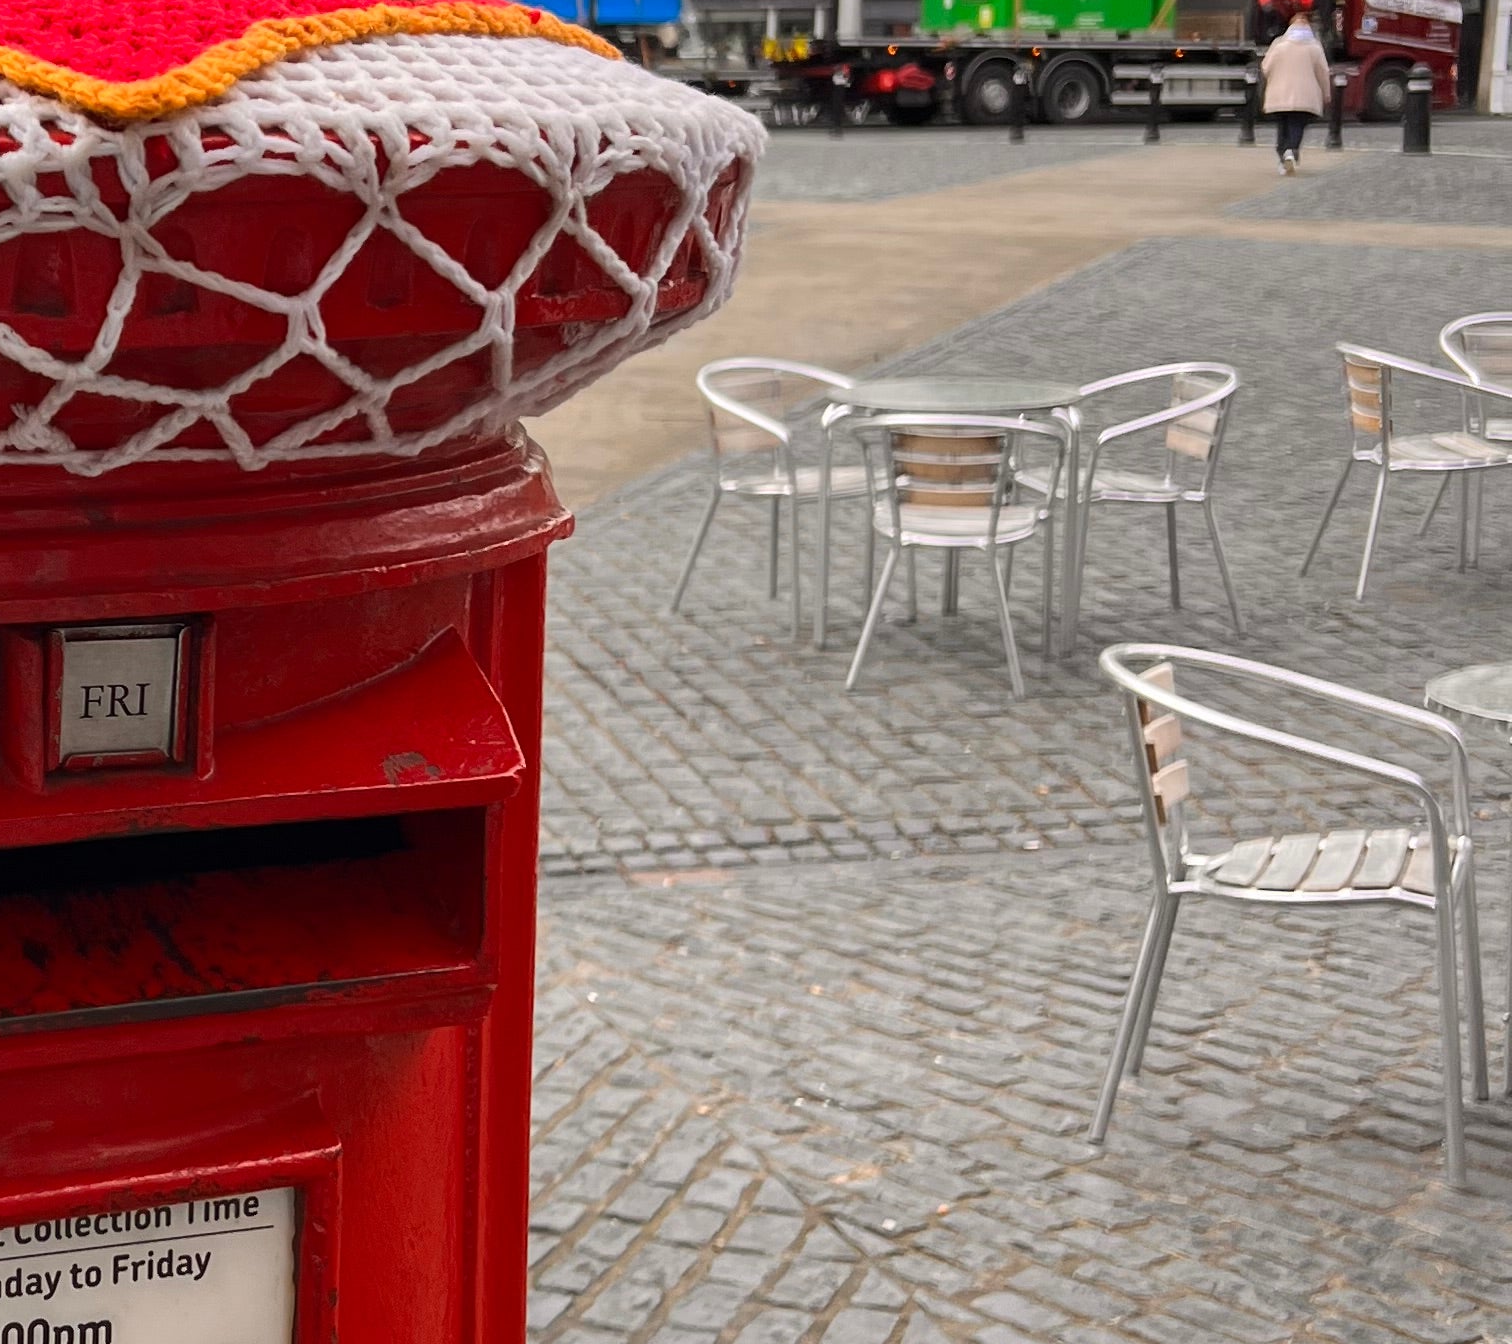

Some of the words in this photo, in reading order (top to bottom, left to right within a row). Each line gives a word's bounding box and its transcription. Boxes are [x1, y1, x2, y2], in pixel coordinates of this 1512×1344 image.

[80, 682, 151, 720] FRI
[15, 1204, 173, 1245] Collection
[71, 1260, 102, 1290] to
[112, 1248, 212, 1284] Friday
